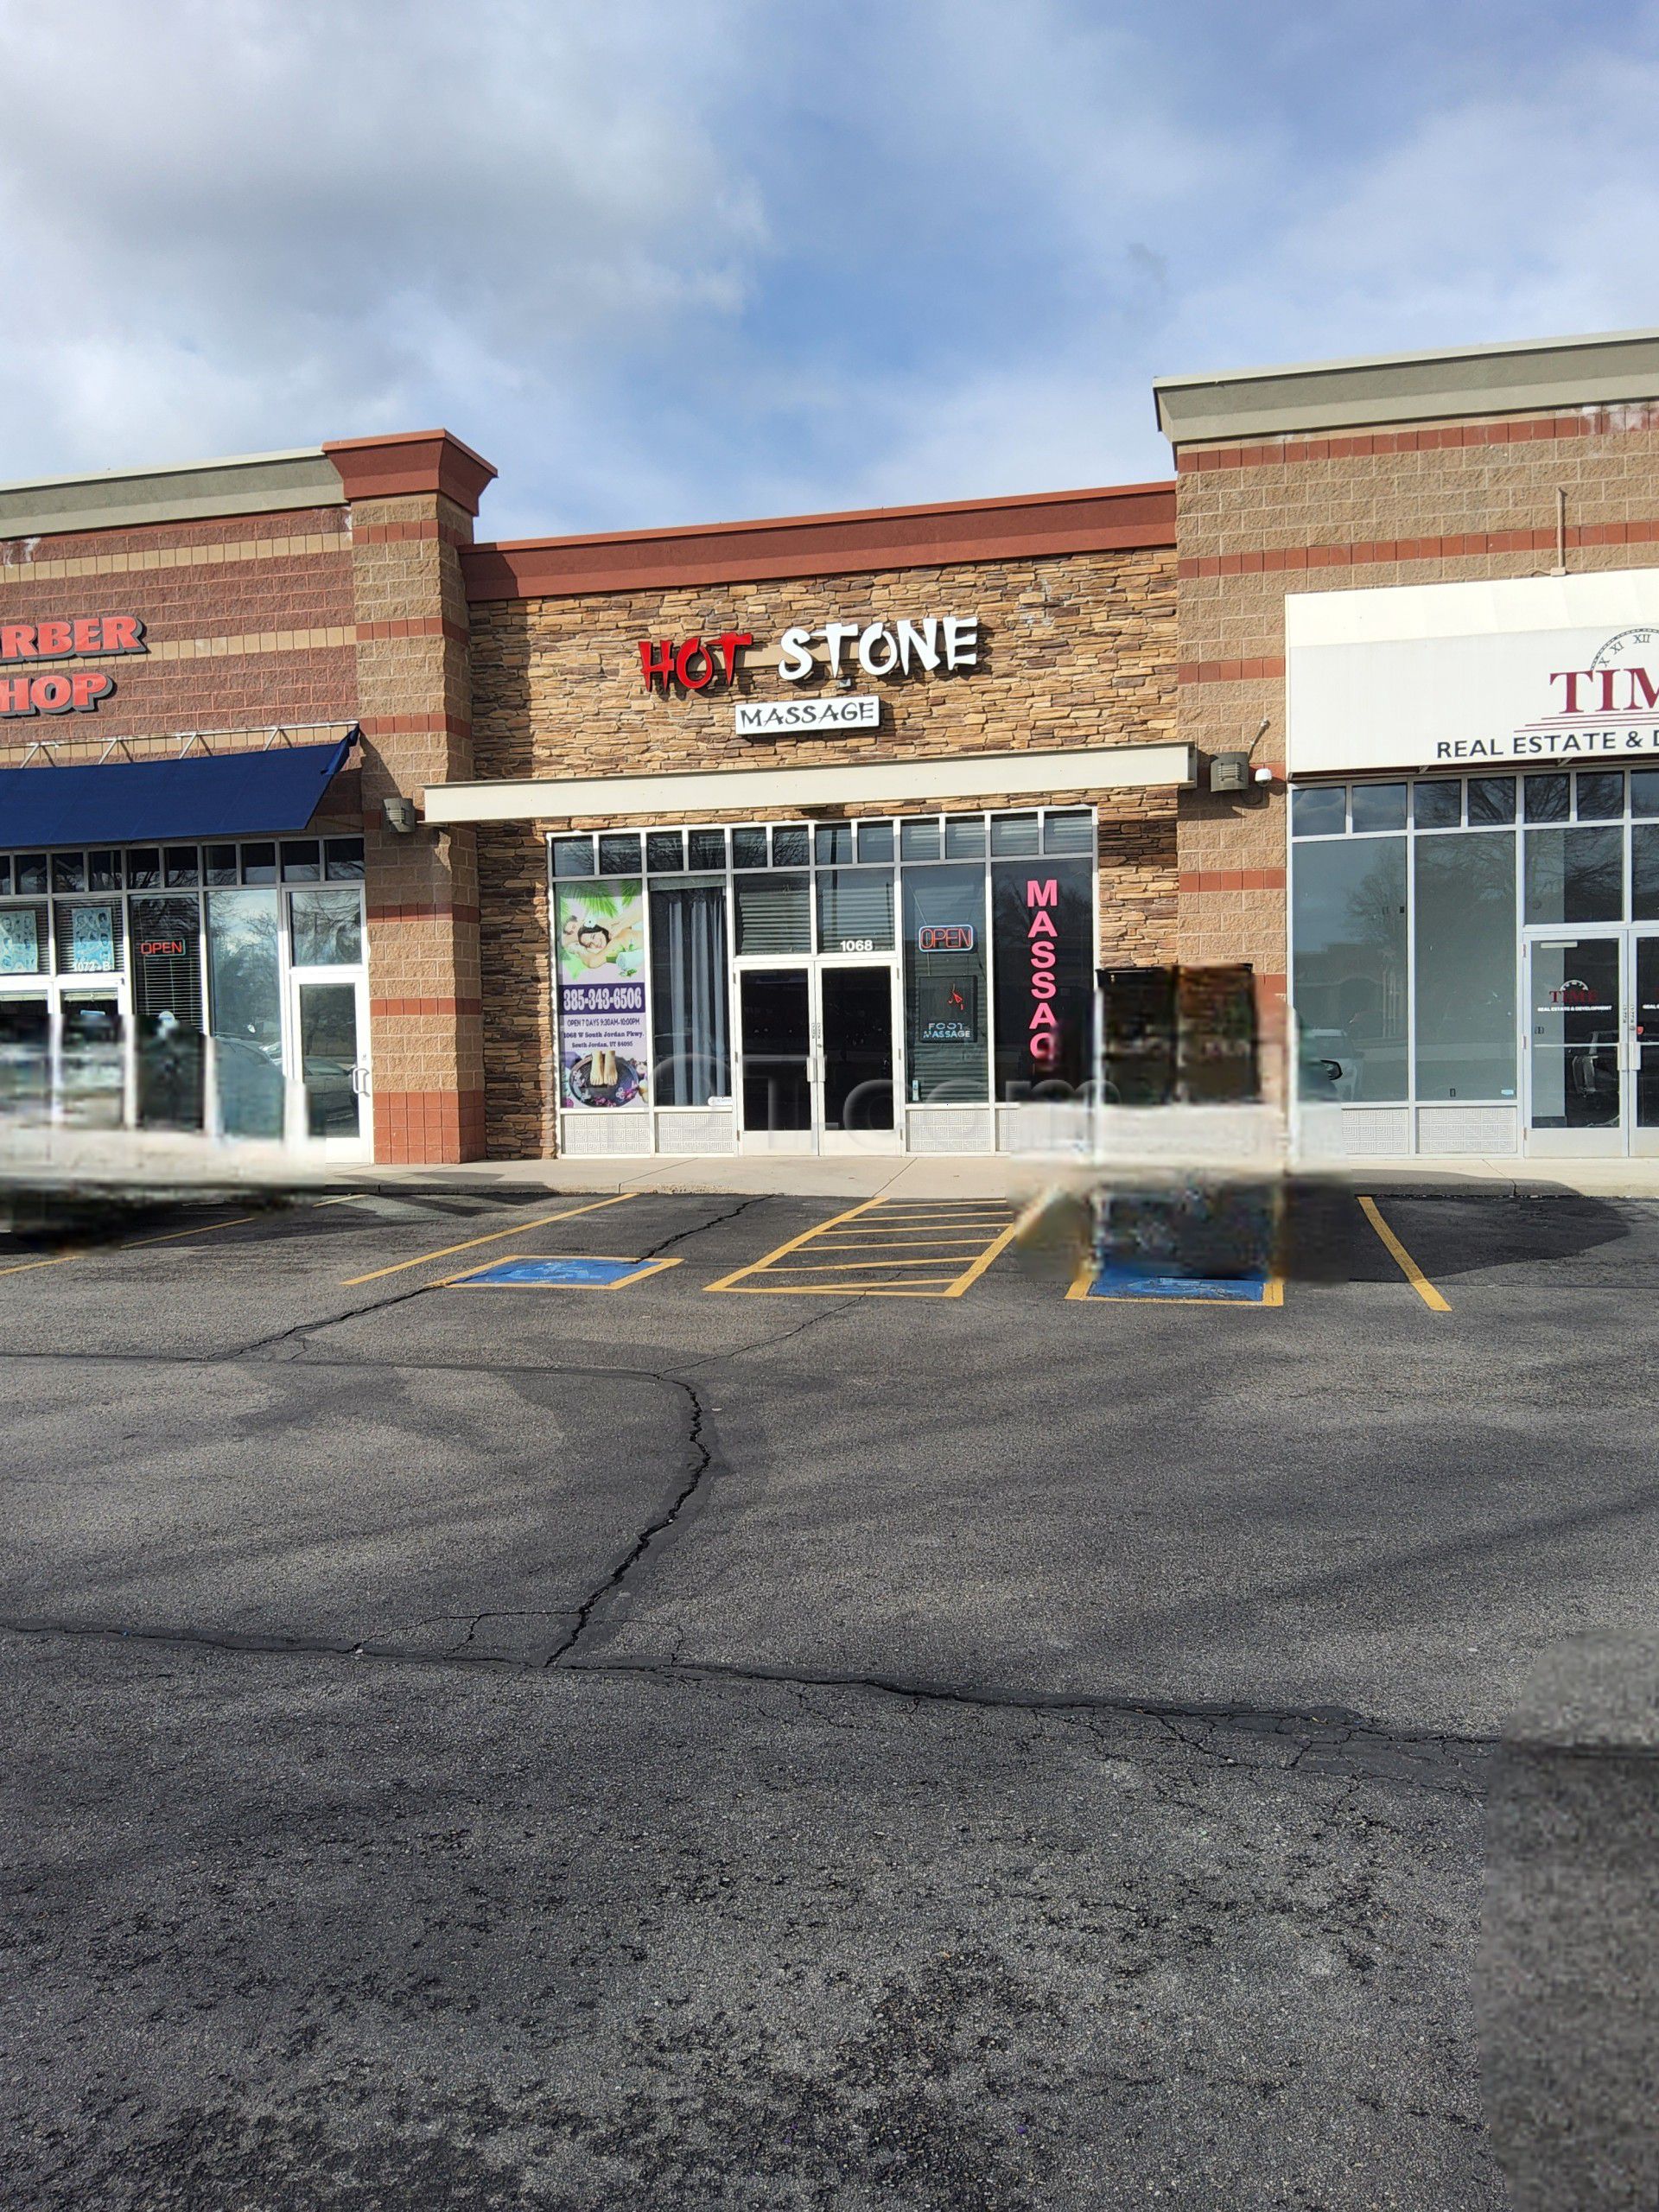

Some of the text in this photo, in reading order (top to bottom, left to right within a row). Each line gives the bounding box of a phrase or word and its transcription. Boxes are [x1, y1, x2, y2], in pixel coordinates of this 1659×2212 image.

[639, 617, 977, 691] HOT STONE
[741, 702, 874, 728] MASSAGE
[1437, 739, 1503, 758] REAL
[1514, 733, 1616, 753] ESTATE
[1626, 731, 1643, 747] &
[141, 940, 182, 955] OPEN
[840, 940, 873, 951] 1068
[920, 927, 971, 949] OPEN
[563, 987, 642, 1010] 385-343-6506
[585, 1018, 599, 1027] DAYS
[923, 1030, 970, 1039] MASSAGE
